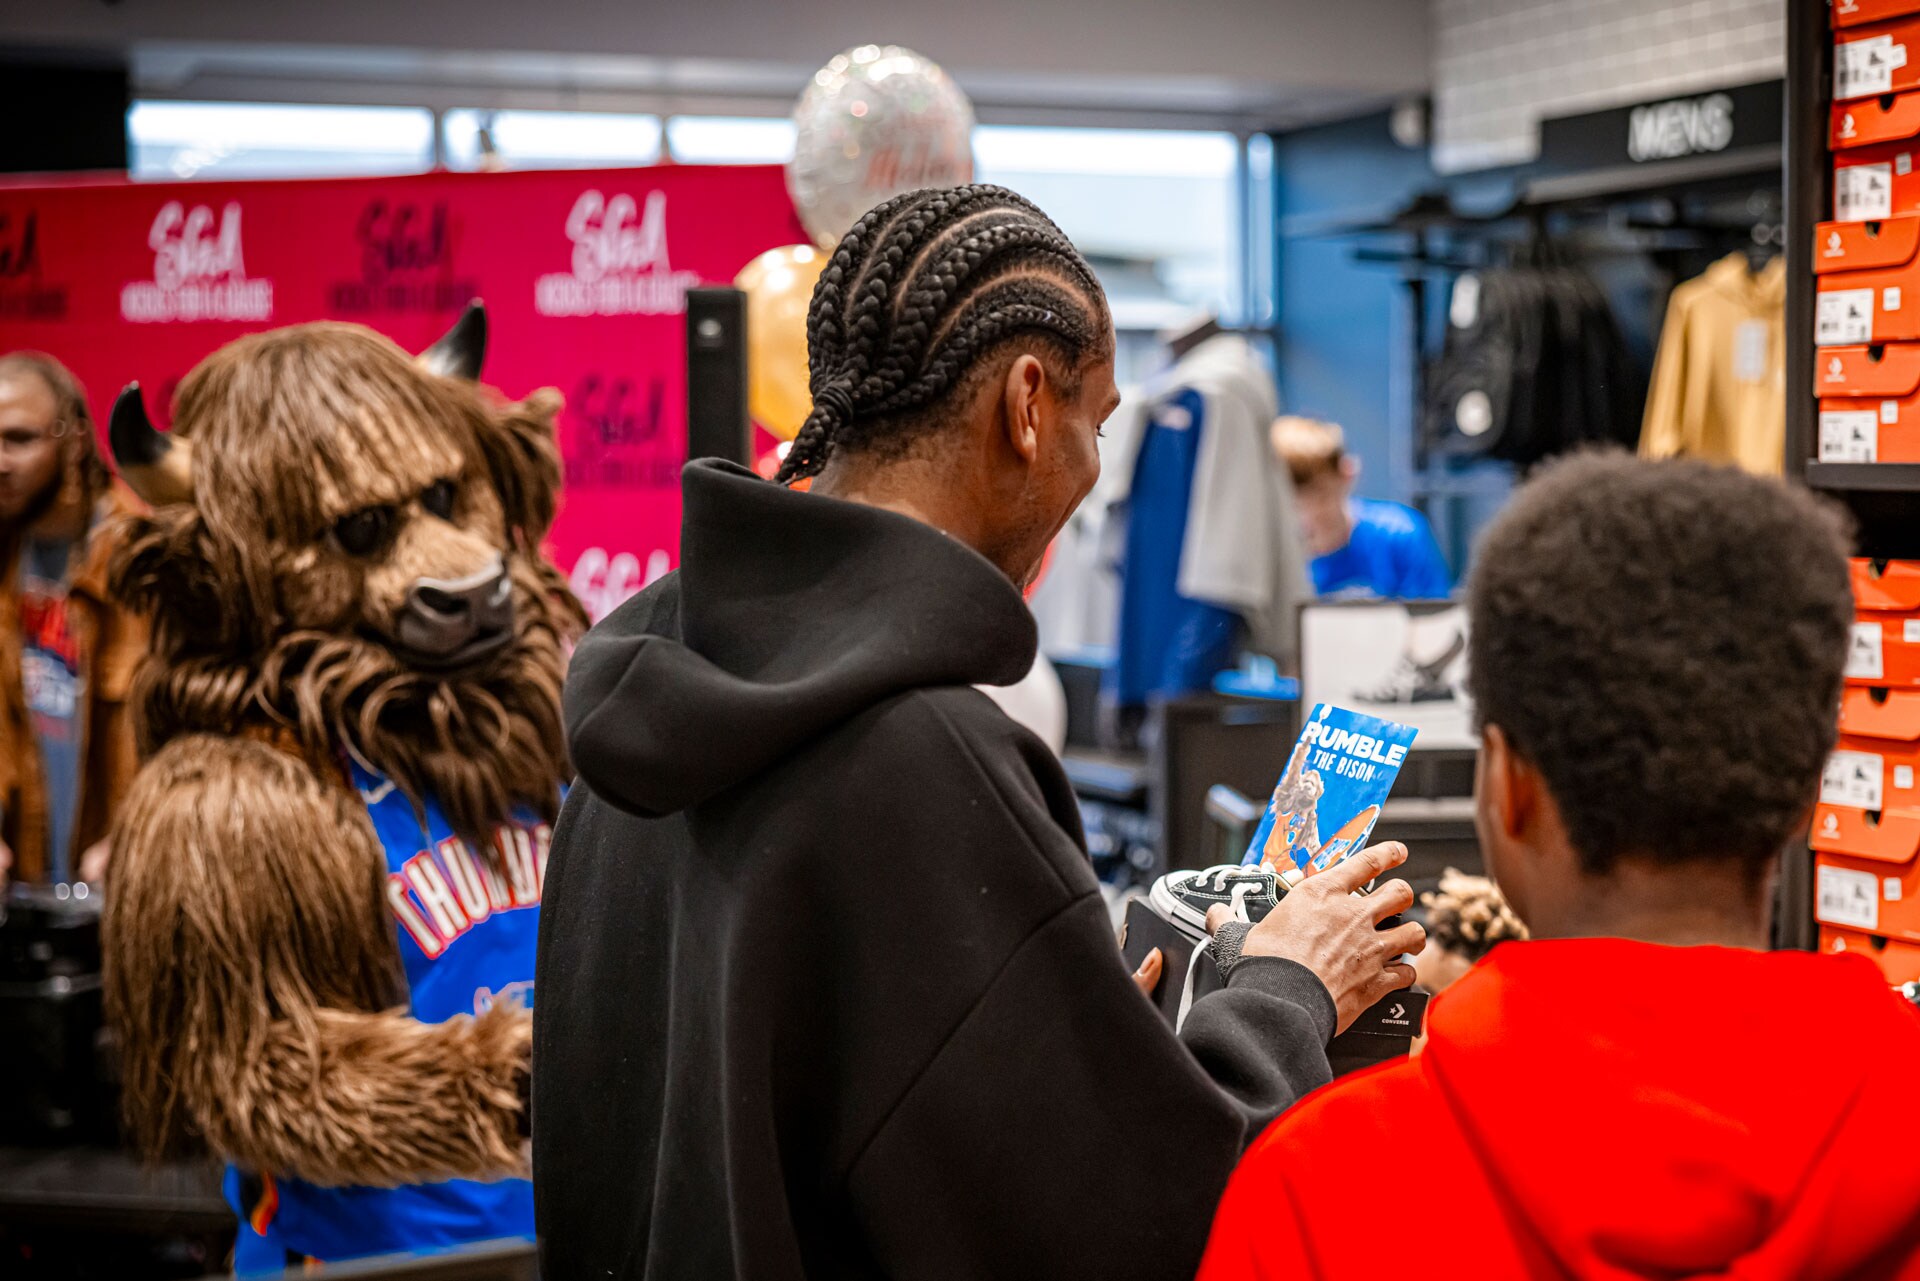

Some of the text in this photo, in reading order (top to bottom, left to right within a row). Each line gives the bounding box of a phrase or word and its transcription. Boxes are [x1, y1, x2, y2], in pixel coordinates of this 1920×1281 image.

[1628, 94, 1733, 161] MENS
[1300, 721, 1408, 768] RUMBLE
[1313, 749, 1376, 782] THE BISON
[1381, 1018, 1409, 1026] CONVERSE
